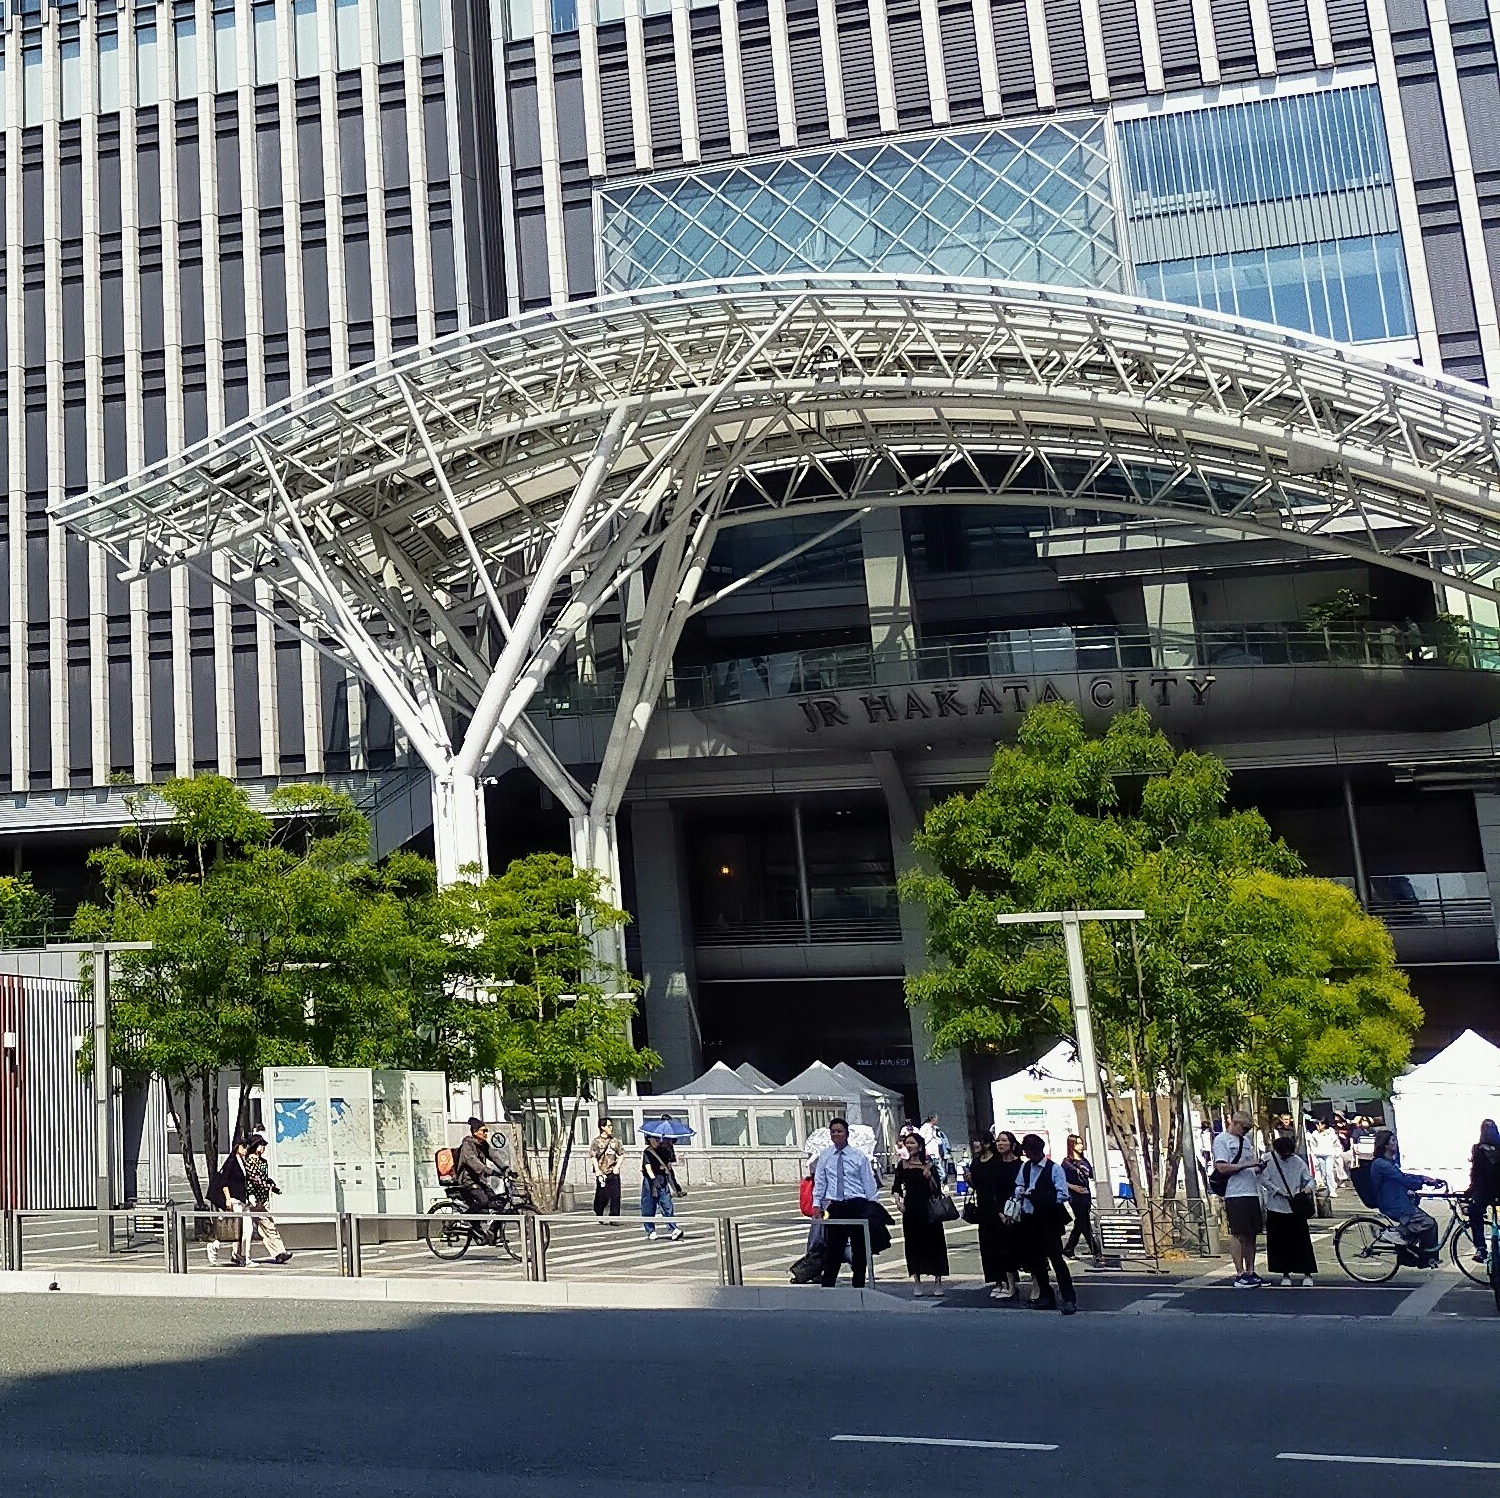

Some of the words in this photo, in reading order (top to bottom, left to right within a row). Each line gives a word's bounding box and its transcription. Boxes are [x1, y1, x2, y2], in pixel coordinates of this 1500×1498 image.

[798, 696, 849, 733] JR
[858, 682, 1065, 724] HAKATA
[1090, 675, 1217, 709] CITY
